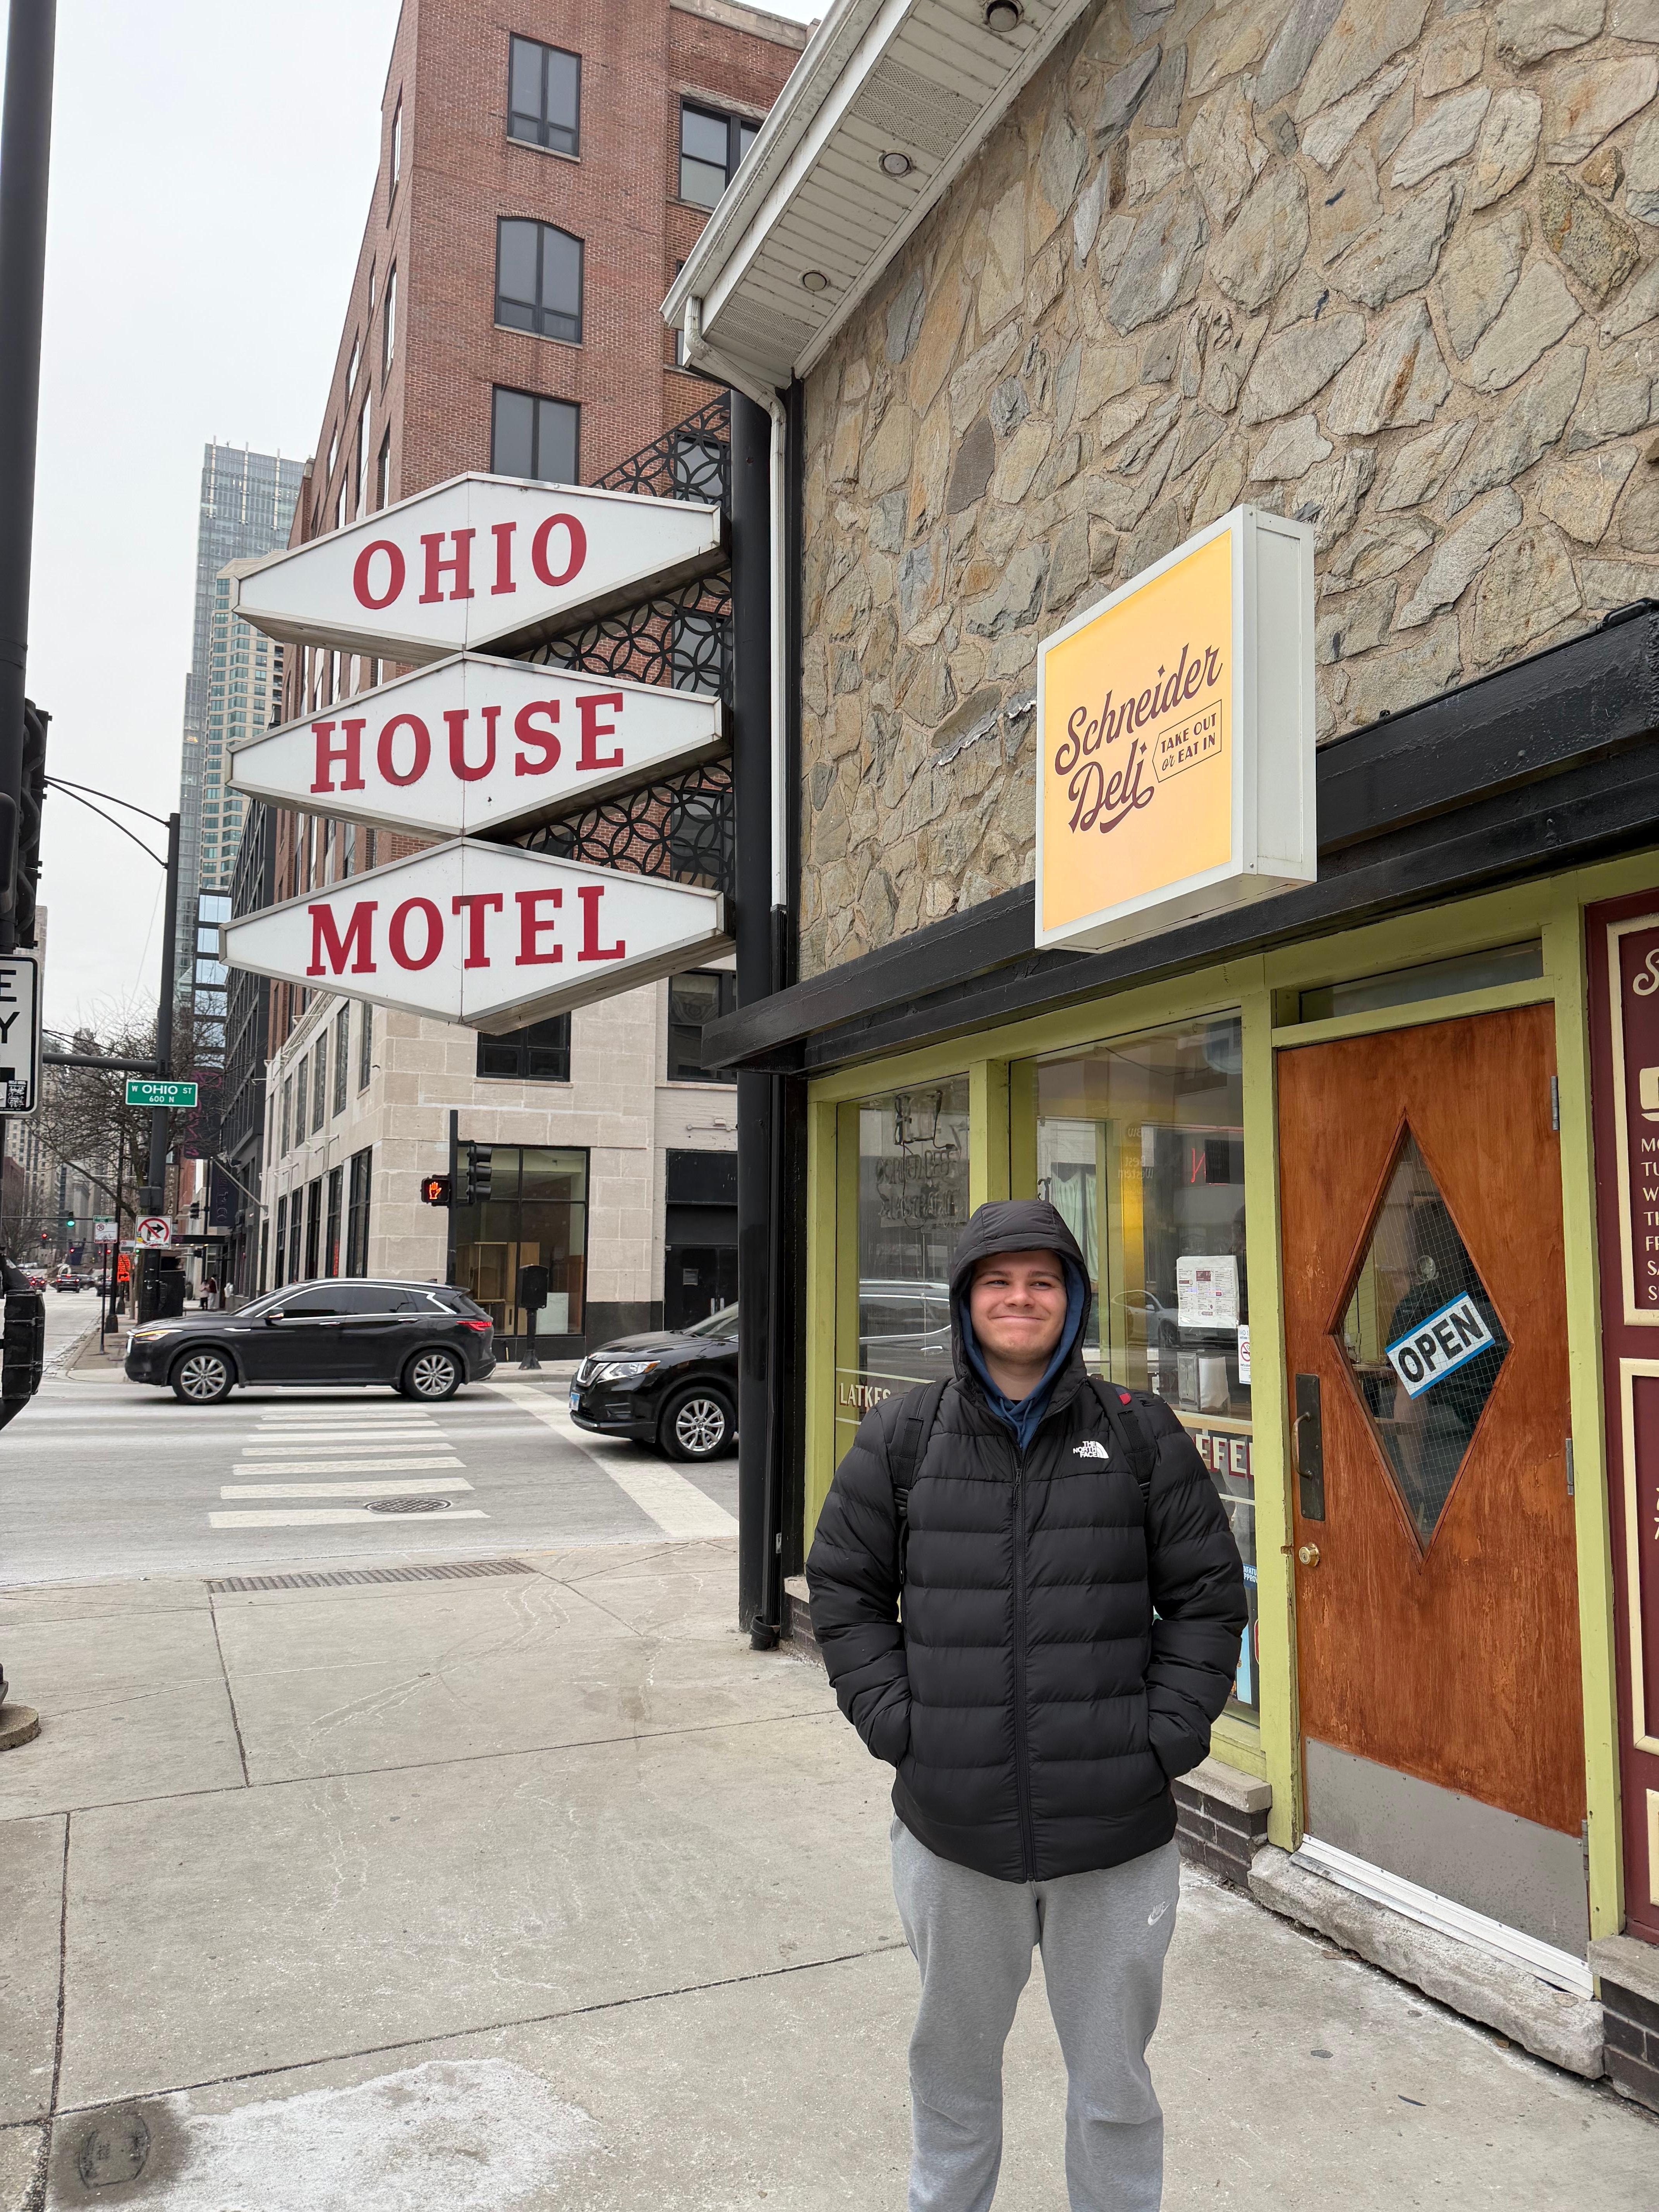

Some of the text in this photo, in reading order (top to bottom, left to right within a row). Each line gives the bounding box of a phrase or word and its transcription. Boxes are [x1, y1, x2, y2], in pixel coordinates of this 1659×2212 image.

[353, 513, 587, 610] OHIO
[310, 692, 624, 793] HOUSE
[1054, 642, 1223, 776] Schneider
[1161, 713, 1216, 753] TAKE OUT
[1162, 732, 1215, 771] or EAT IN
[1067, 737, 1155, 834] Deli
[306, 885, 626, 976] MOTEL
[142, 1085, 178, 1095] OHIO
[1398, 1304, 1484, 1383] OPEN
[1152, 1901, 1166, 1917] NIKE
